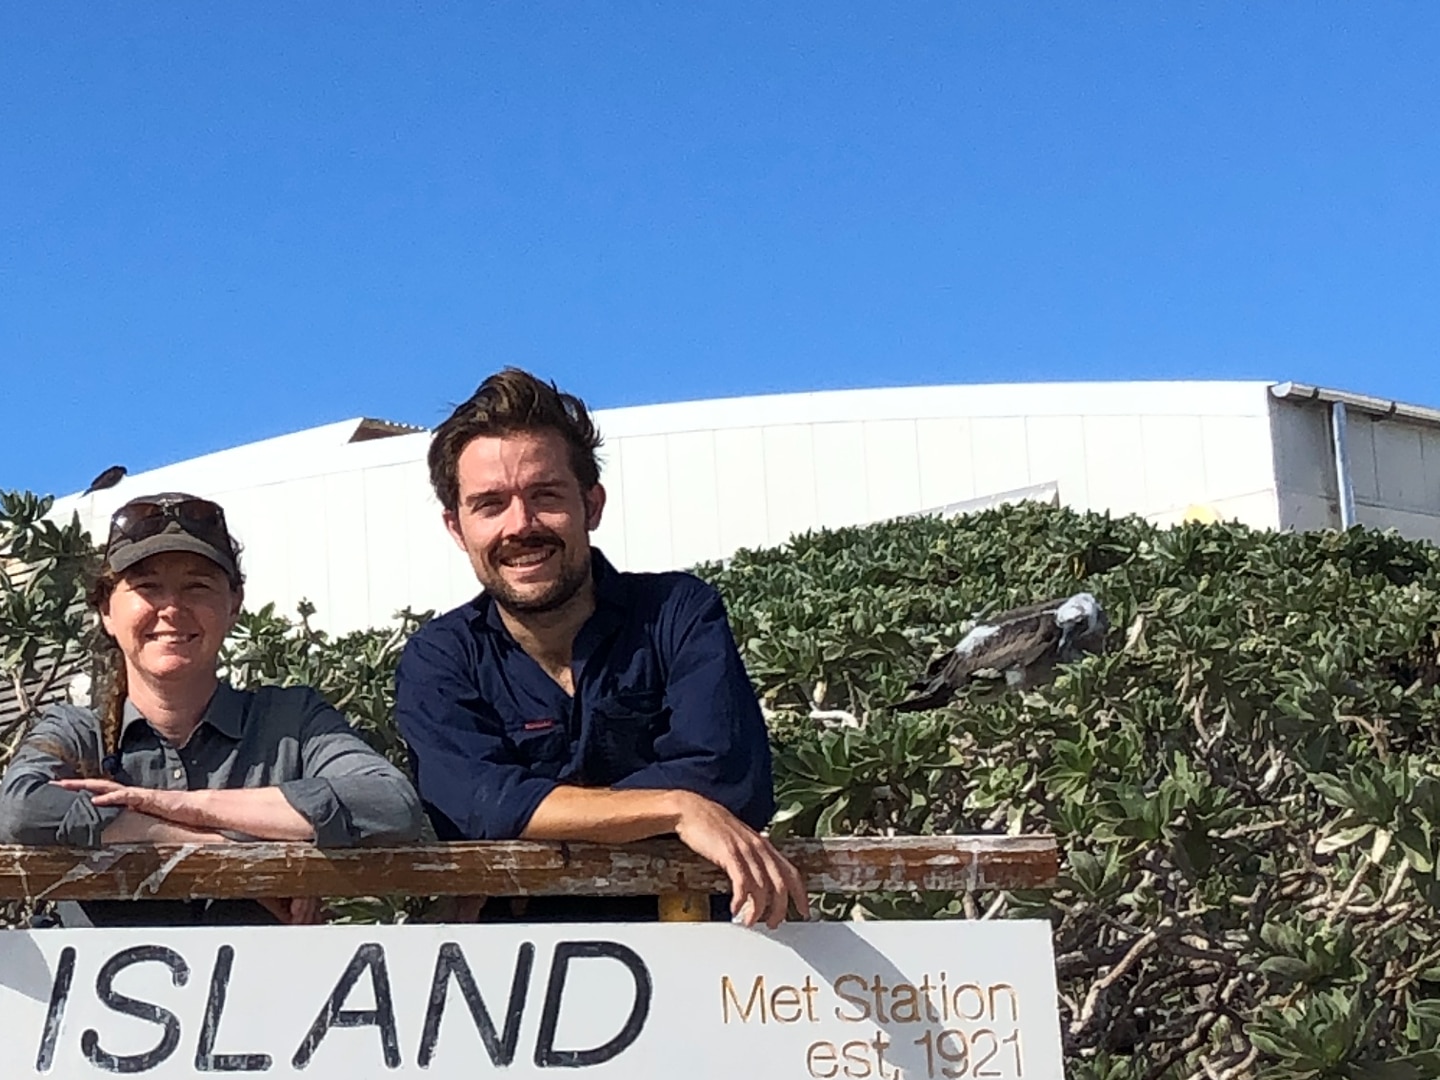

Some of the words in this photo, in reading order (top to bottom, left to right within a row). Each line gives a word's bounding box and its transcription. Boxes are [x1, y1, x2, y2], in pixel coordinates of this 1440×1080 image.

[35, 940, 654, 1073] ISLAND
[720, 975, 820, 1024] Met
[832, 971, 1020, 1024] Station
[913, 1027, 1024, 1079] 1921
